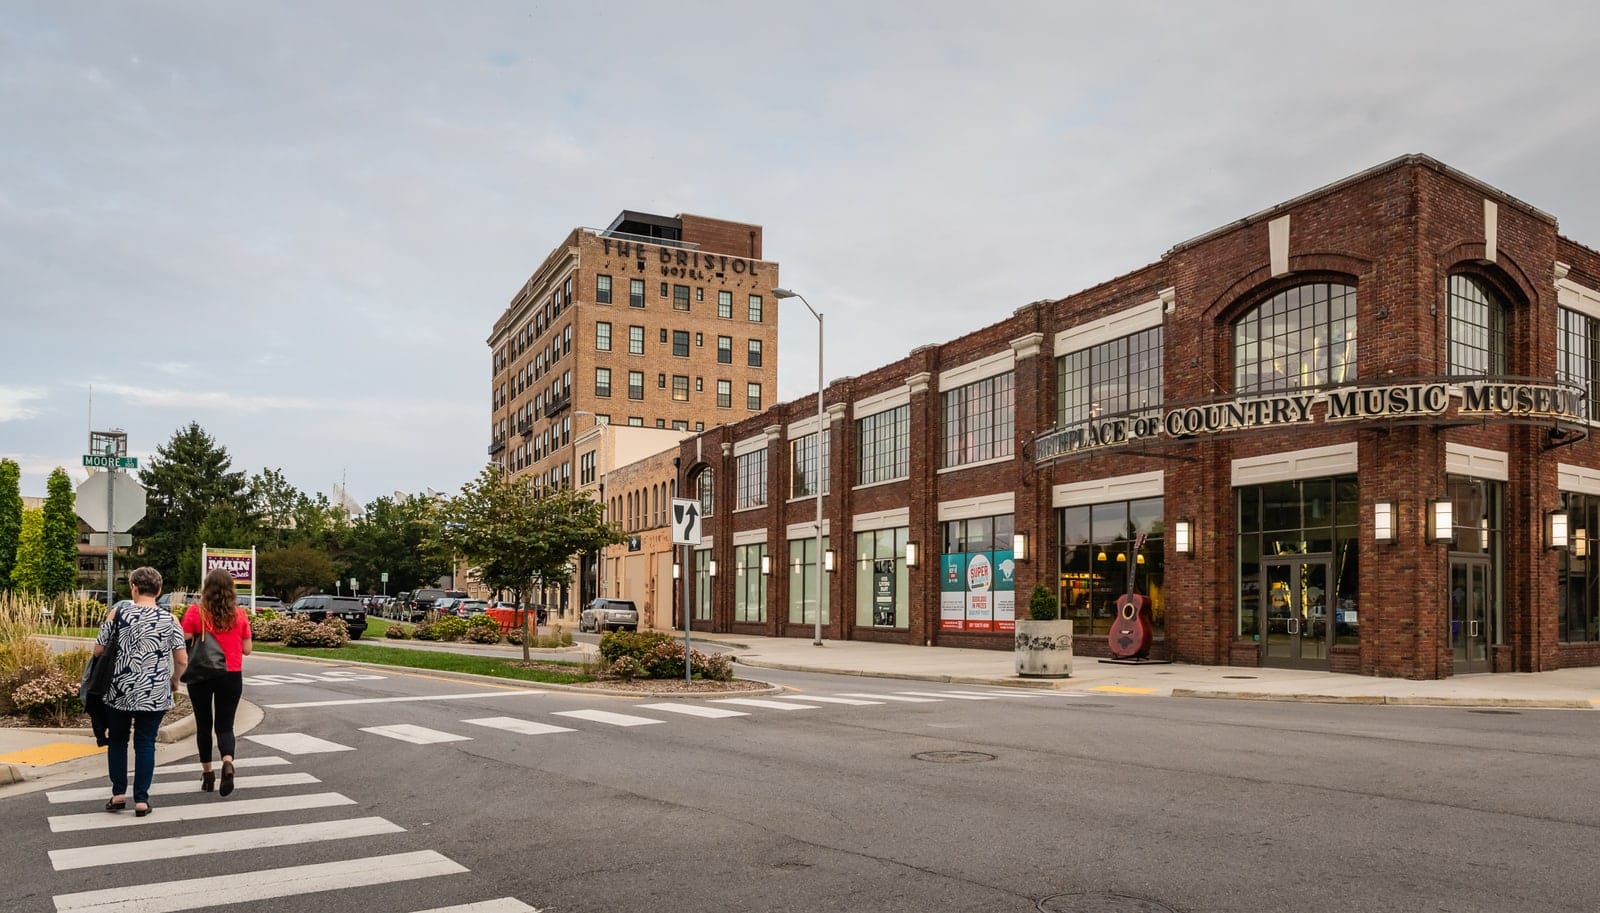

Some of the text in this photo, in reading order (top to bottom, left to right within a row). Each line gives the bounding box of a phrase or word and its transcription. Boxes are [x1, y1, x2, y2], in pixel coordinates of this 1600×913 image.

[603, 239, 758, 276] THE BRISTOL
[661, 265, 704, 281] HOTEL
[1134, 416, 1159, 438] OF
[1166, 395, 1315, 437] COUNTRY
[1328, 384, 1447, 418] MUSIC
[1463, 384, 1581, 417] MUSEUM
[85, 456, 121, 467] MOORE
[208, 560, 250, 571] MAIN
[970, 565, 989, 579] SUPER
